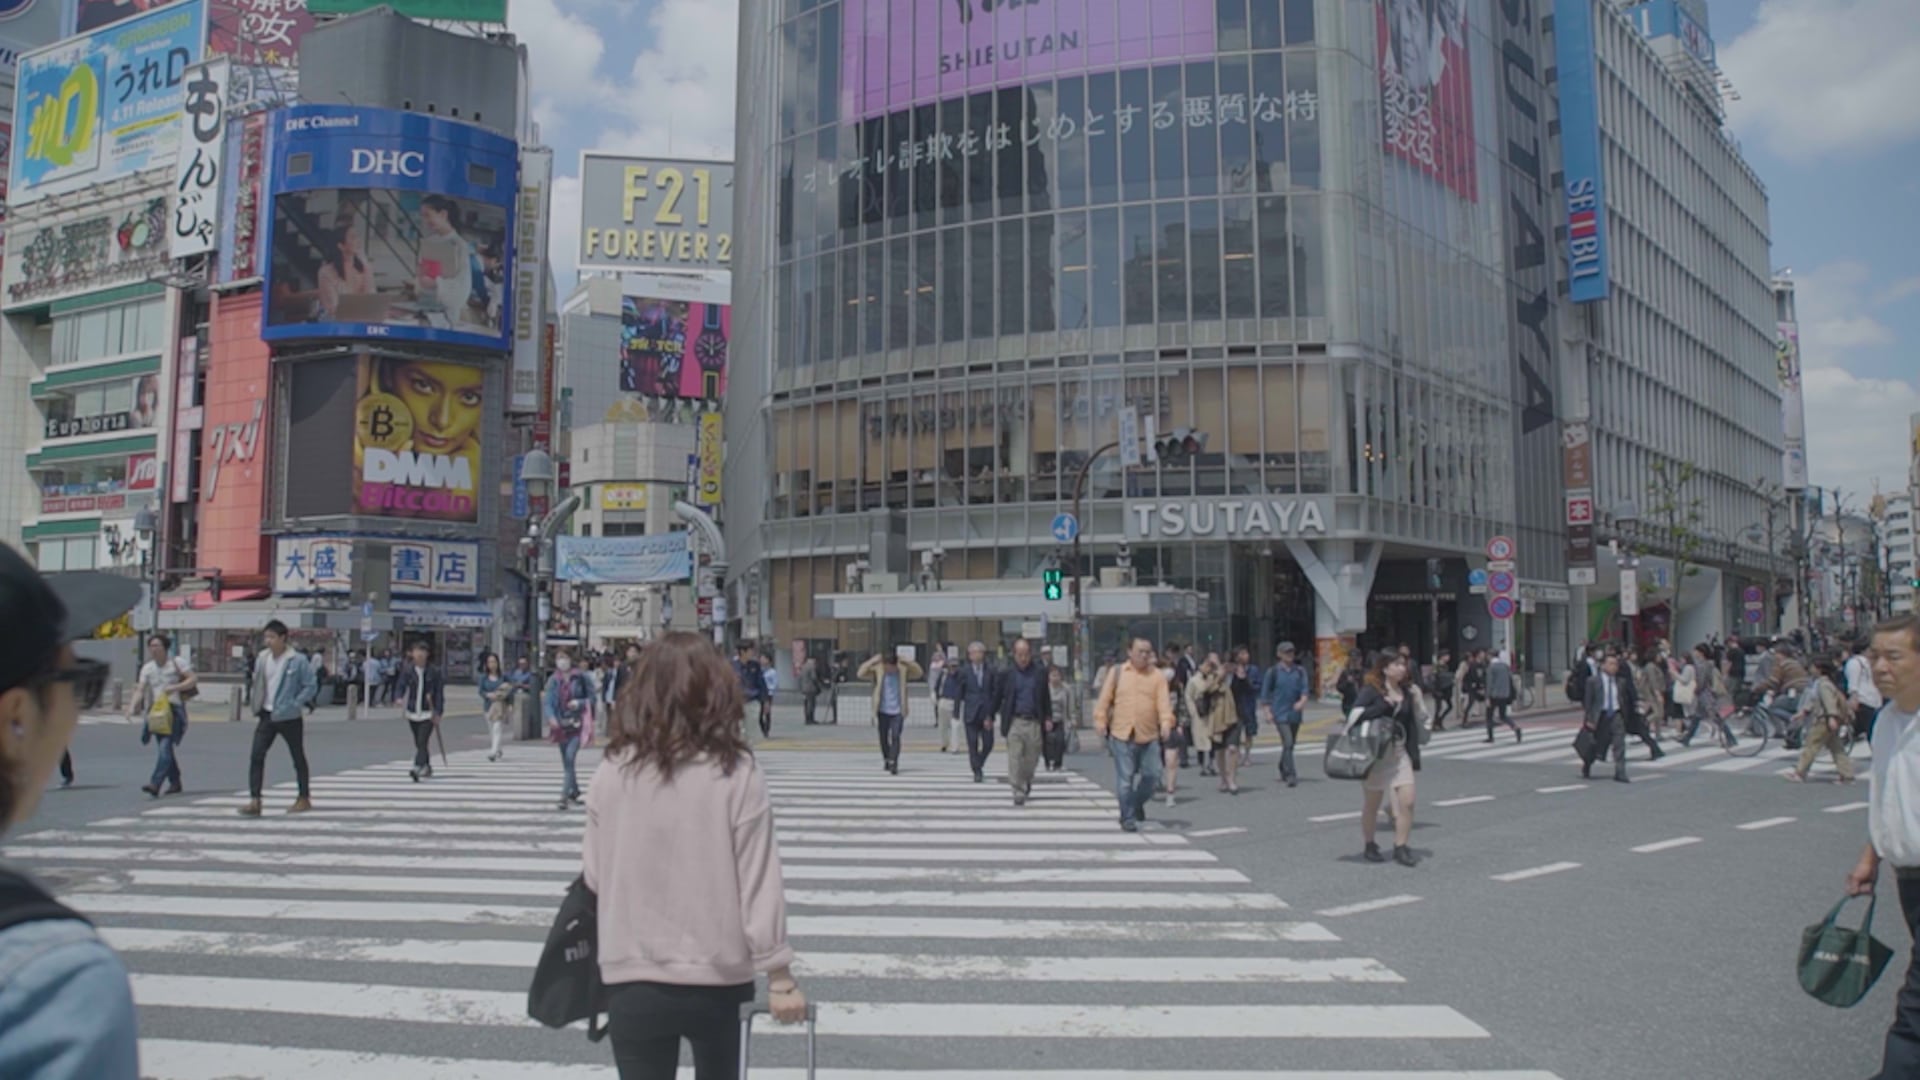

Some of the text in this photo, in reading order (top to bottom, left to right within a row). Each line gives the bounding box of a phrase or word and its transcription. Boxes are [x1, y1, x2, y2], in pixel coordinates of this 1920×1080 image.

[286, 115, 358, 131] DHC Channel
[176, 66, 222, 246] もんじゃ
[350, 149, 424, 177] DHC
[622, 165, 712, 226] F21
[586, 228, 709, 261] FOREVER
[1568, 178, 1600, 278] SEIBU
[517, 271, 537, 341] neon
[367, 326, 389, 336] DHC
[207, 398, 265, 501] クスリ
[363, 446, 472, 490] DMM
[360, 484, 471, 513] Bitcoin
[1133, 500, 1325, 536] TSUTAYA
[284, 545, 467, 583] 大盛書店
